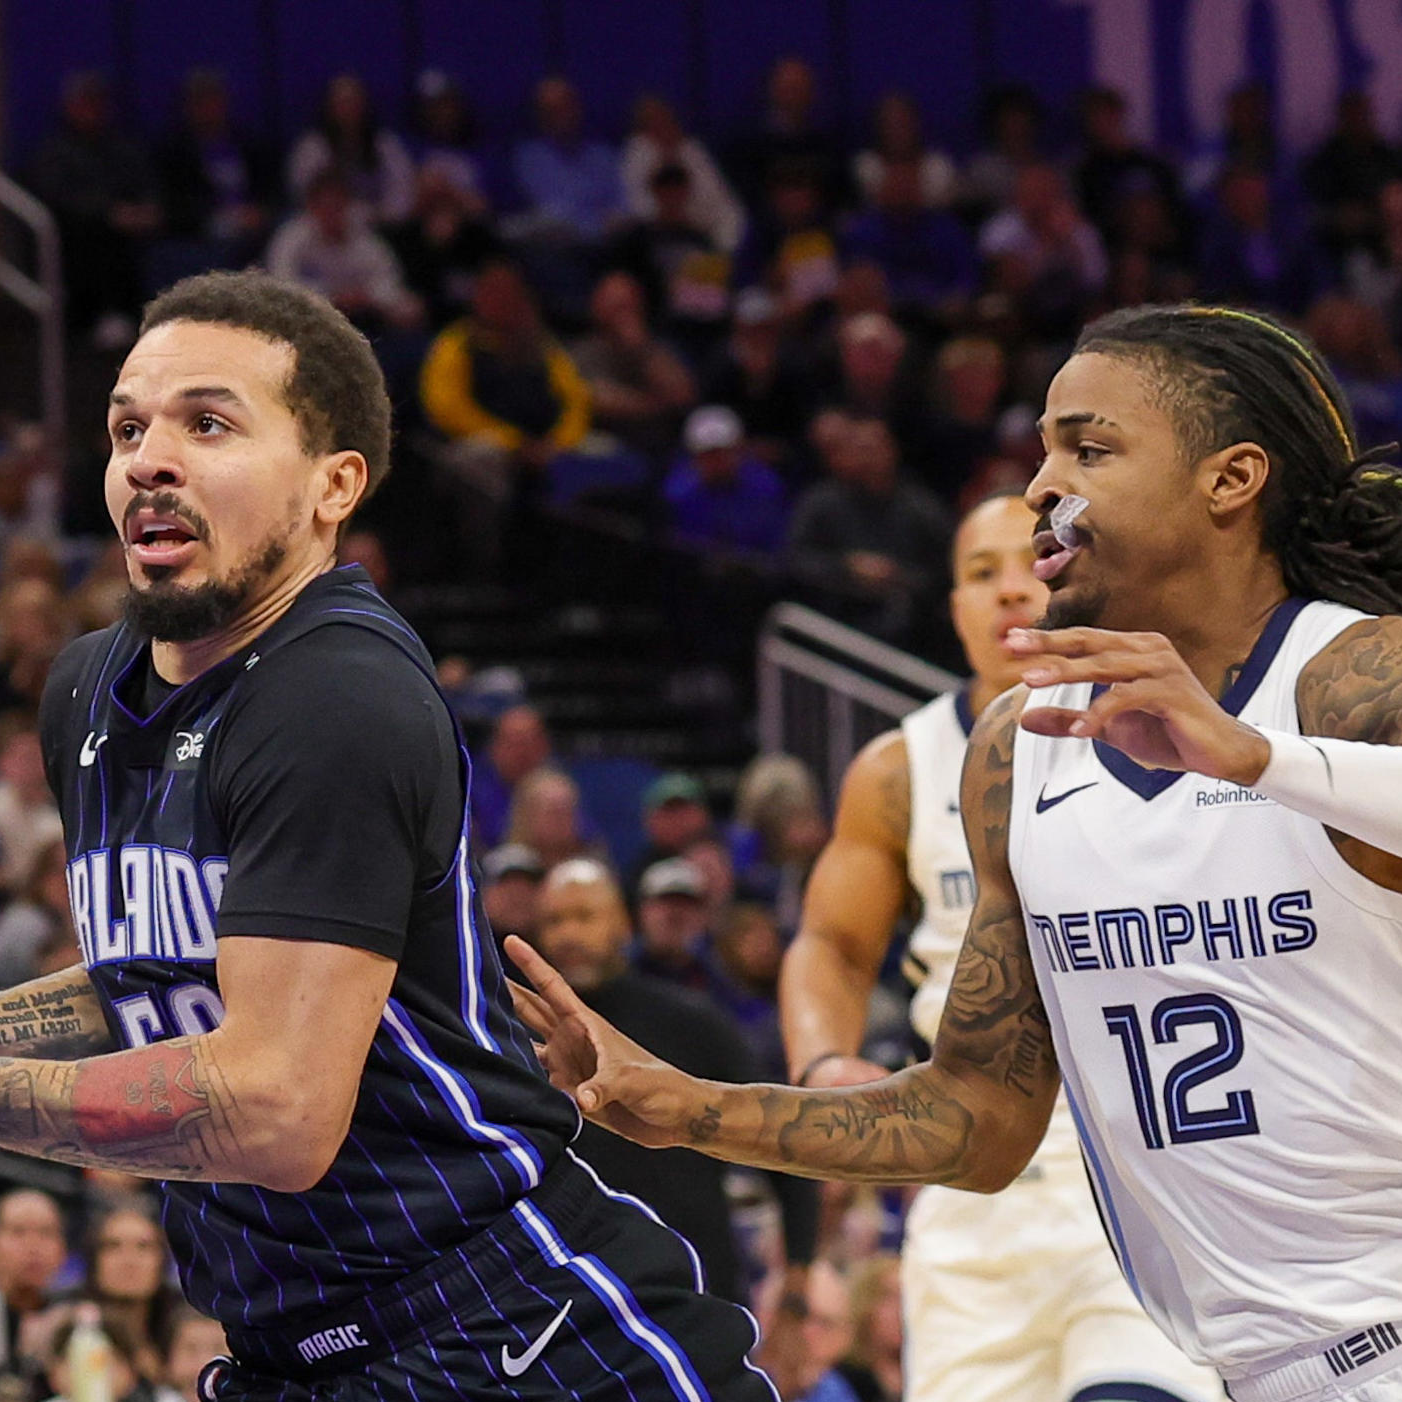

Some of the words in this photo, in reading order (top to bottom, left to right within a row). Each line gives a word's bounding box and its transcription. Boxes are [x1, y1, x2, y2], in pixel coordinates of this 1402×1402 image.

[66, 843, 229, 971] RLAND
[1031, 889, 1318, 973] MEMPHIS
[1, 996, 28, 1011] and
[1101, 992, 1261, 1150] 12
[297, 1323, 370, 1365] MAGIC
